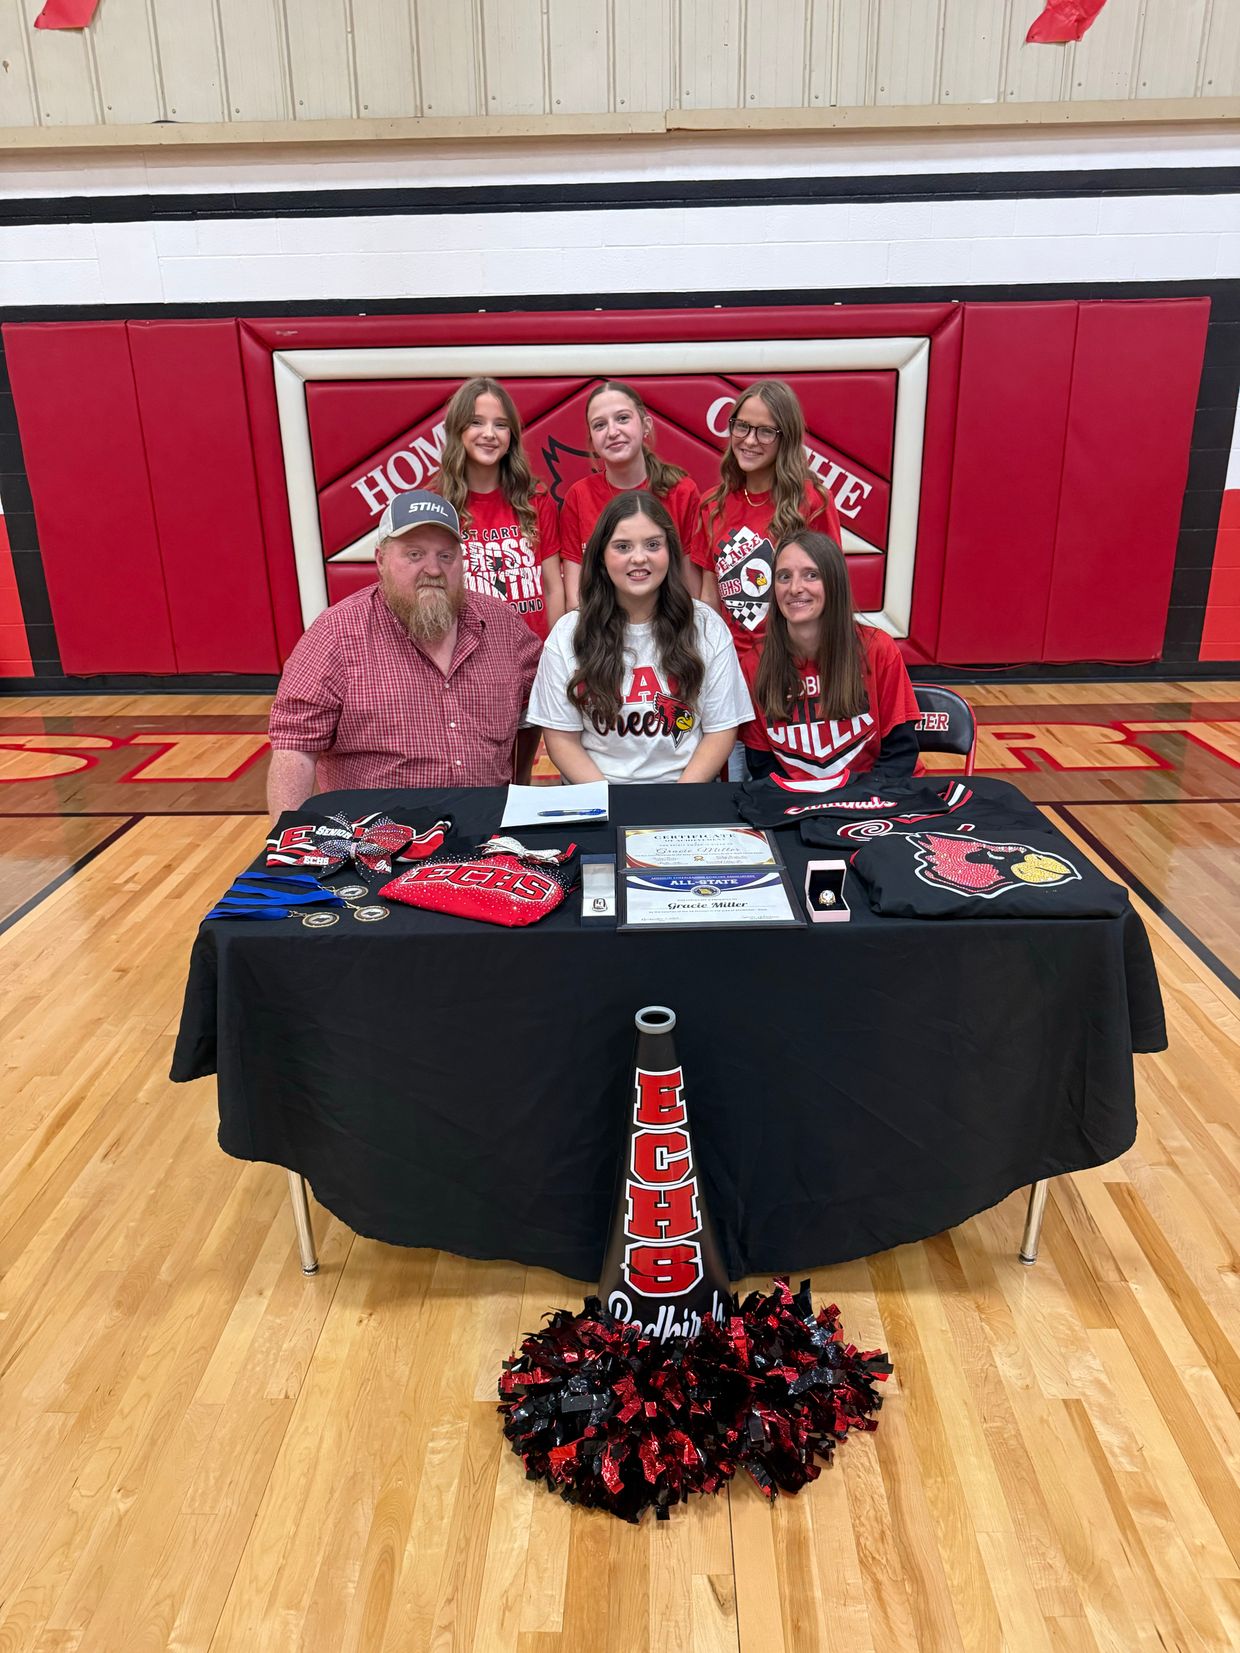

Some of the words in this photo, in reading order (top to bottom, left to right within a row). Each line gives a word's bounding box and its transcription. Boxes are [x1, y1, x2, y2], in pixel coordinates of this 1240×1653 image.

[803, 445, 872, 519] HE
[408, 501, 449, 517] STIHL
[483, 525, 532, 541] CART
[719, 579, 742, 597] CHS
[399, 862, 556, 903] ECHS
[667, 902, 708, 910] Gracie
[624, 1066, 704, 1298] ECHS
